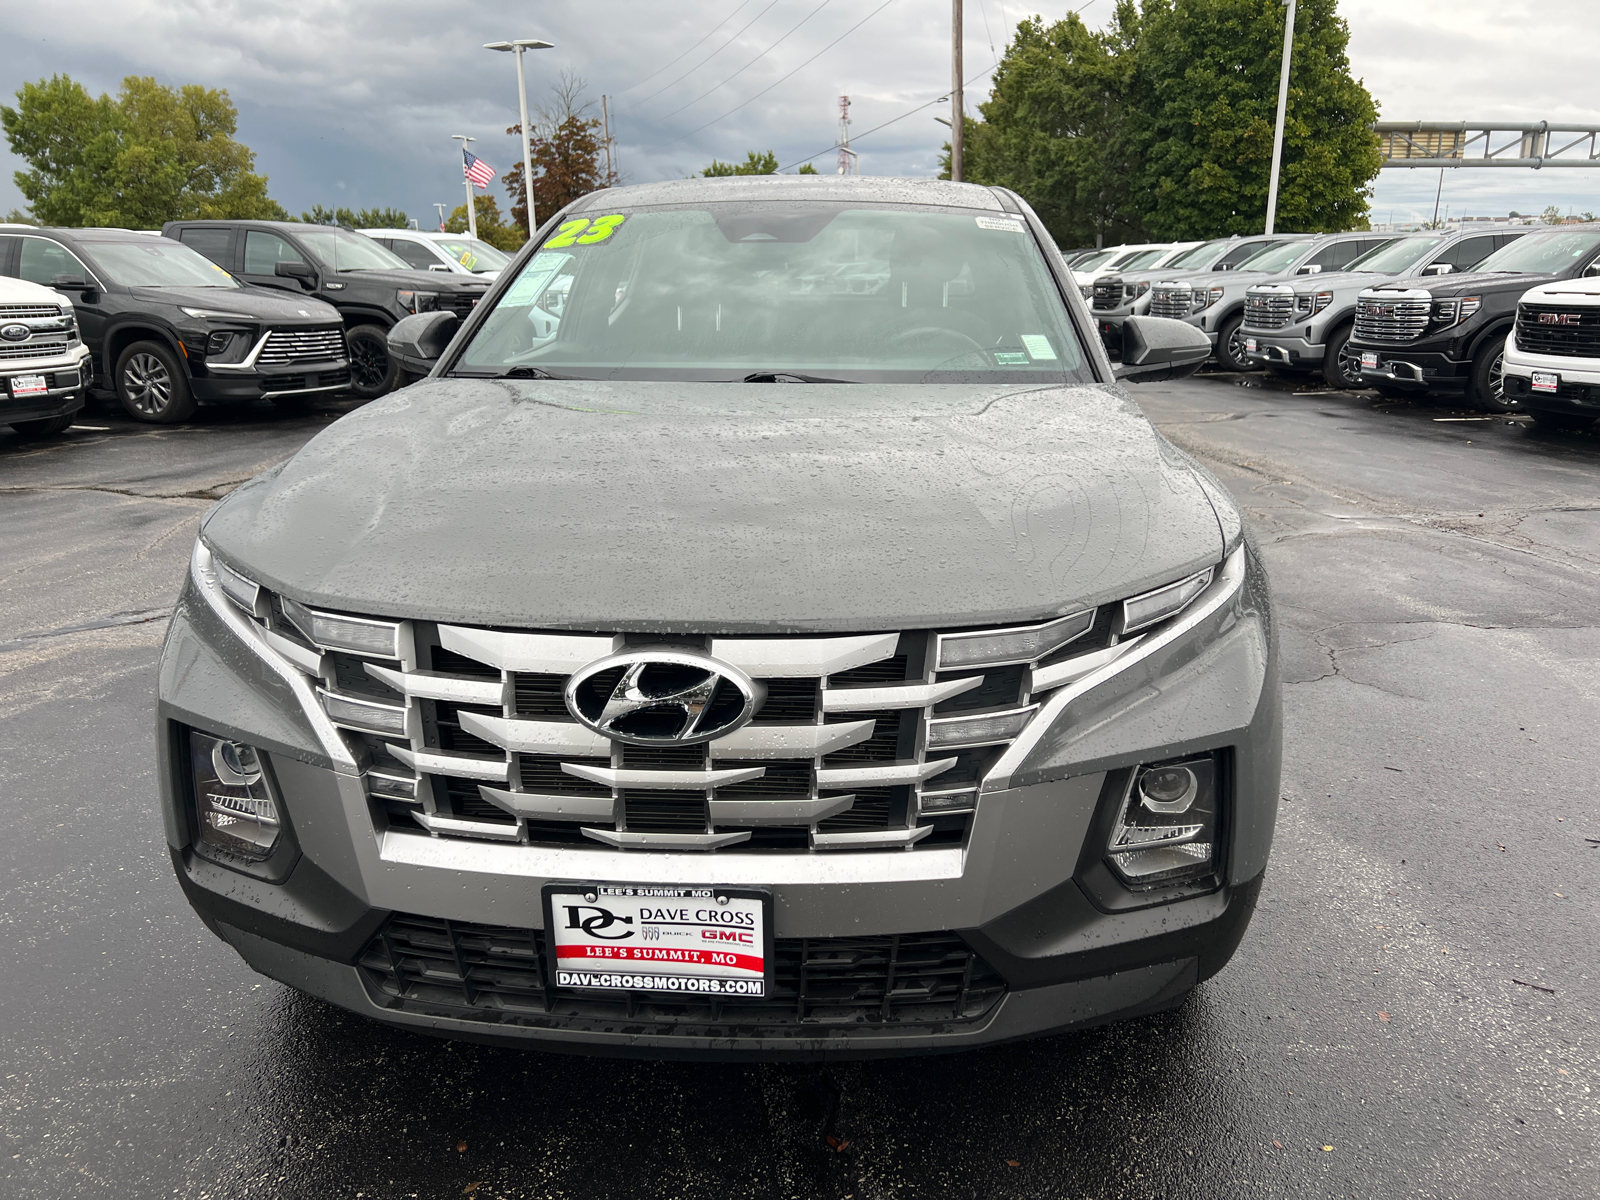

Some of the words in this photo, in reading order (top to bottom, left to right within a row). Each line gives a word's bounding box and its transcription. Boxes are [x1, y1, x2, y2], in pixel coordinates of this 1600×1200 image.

[543, 214, 625, 249] 23
[1538, 313, 1582, 325] GMC
[600, 888, 635, 897] LEE'S
[637, 888, 686, 898] SUMMIT
[692, 890, 711, 898] MO
[640, 908, 689, 921] DAVE
[696, 909, 754, 925] CROSS
[701, 929, 753, 944] GMC
[586, 946, 627, 957] LEE'S
[634, 949, 705, 963] SUMMIT,
[711, 953, 737, 965] MO
